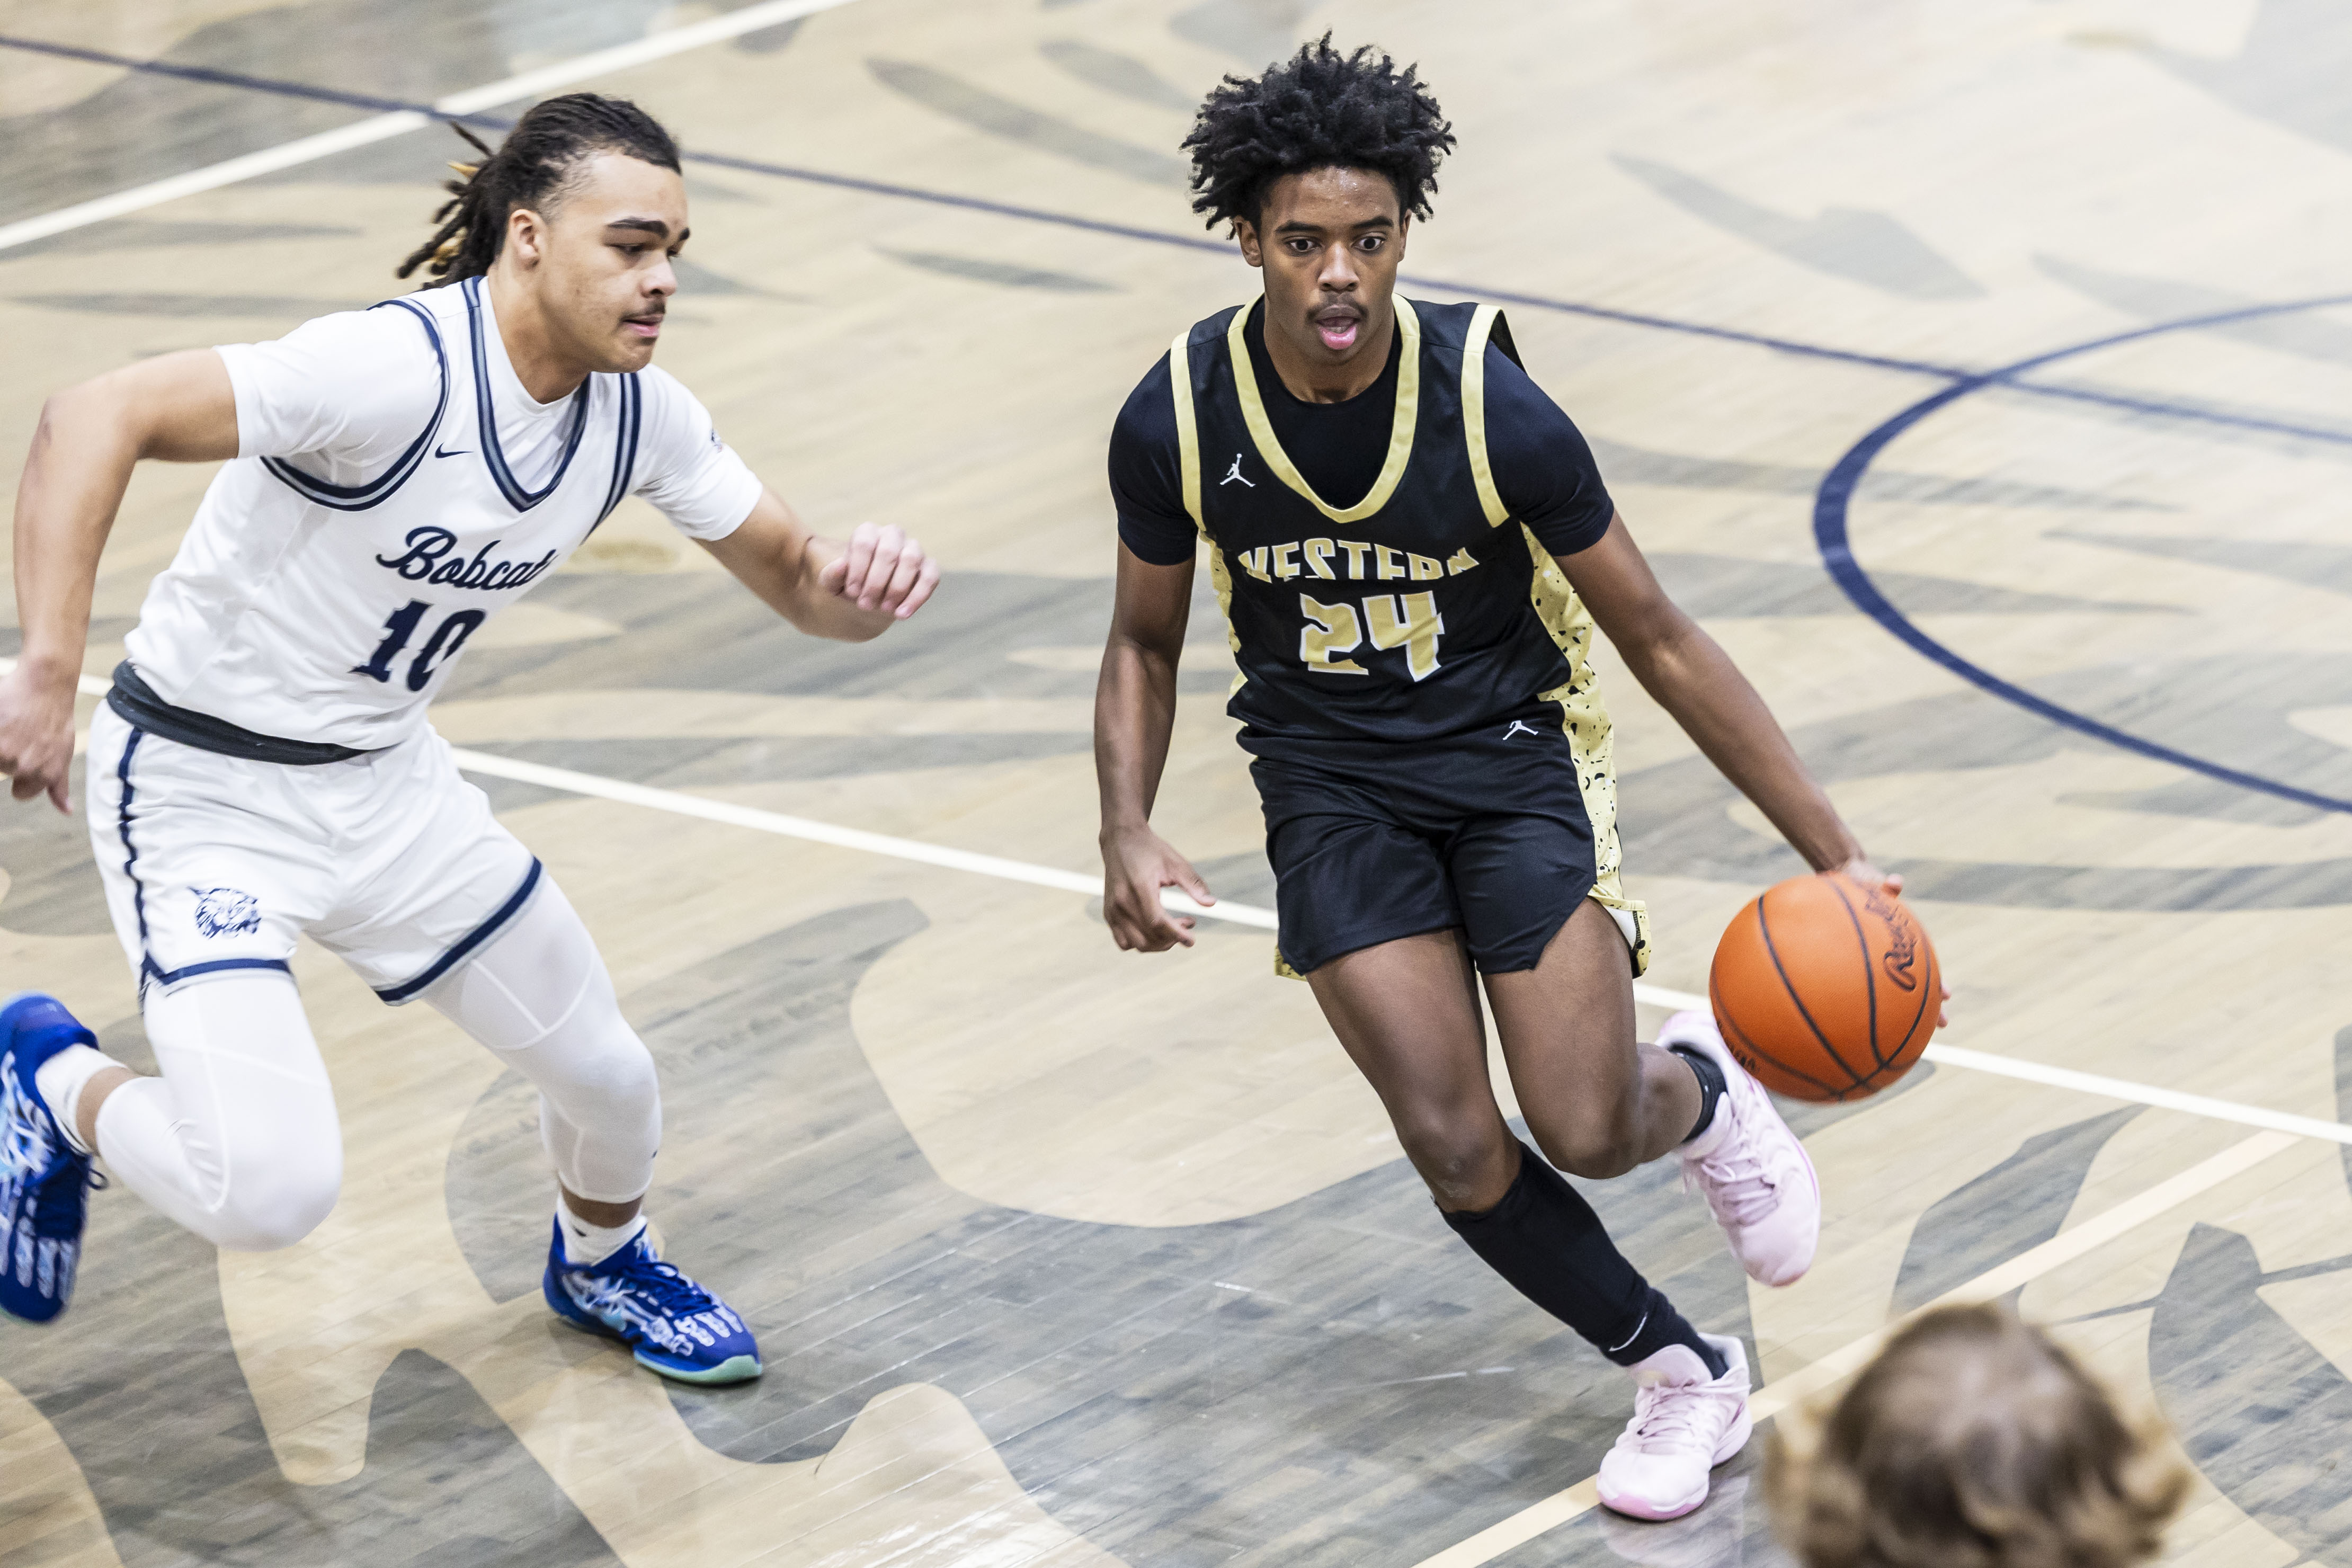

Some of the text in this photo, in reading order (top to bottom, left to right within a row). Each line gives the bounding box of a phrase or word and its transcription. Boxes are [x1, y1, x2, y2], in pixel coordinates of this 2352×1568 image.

[375, 525, 560, 590] Bobcat
[348, 597, 487, 692] 10
[1299, 590, 1445, 682] 24
